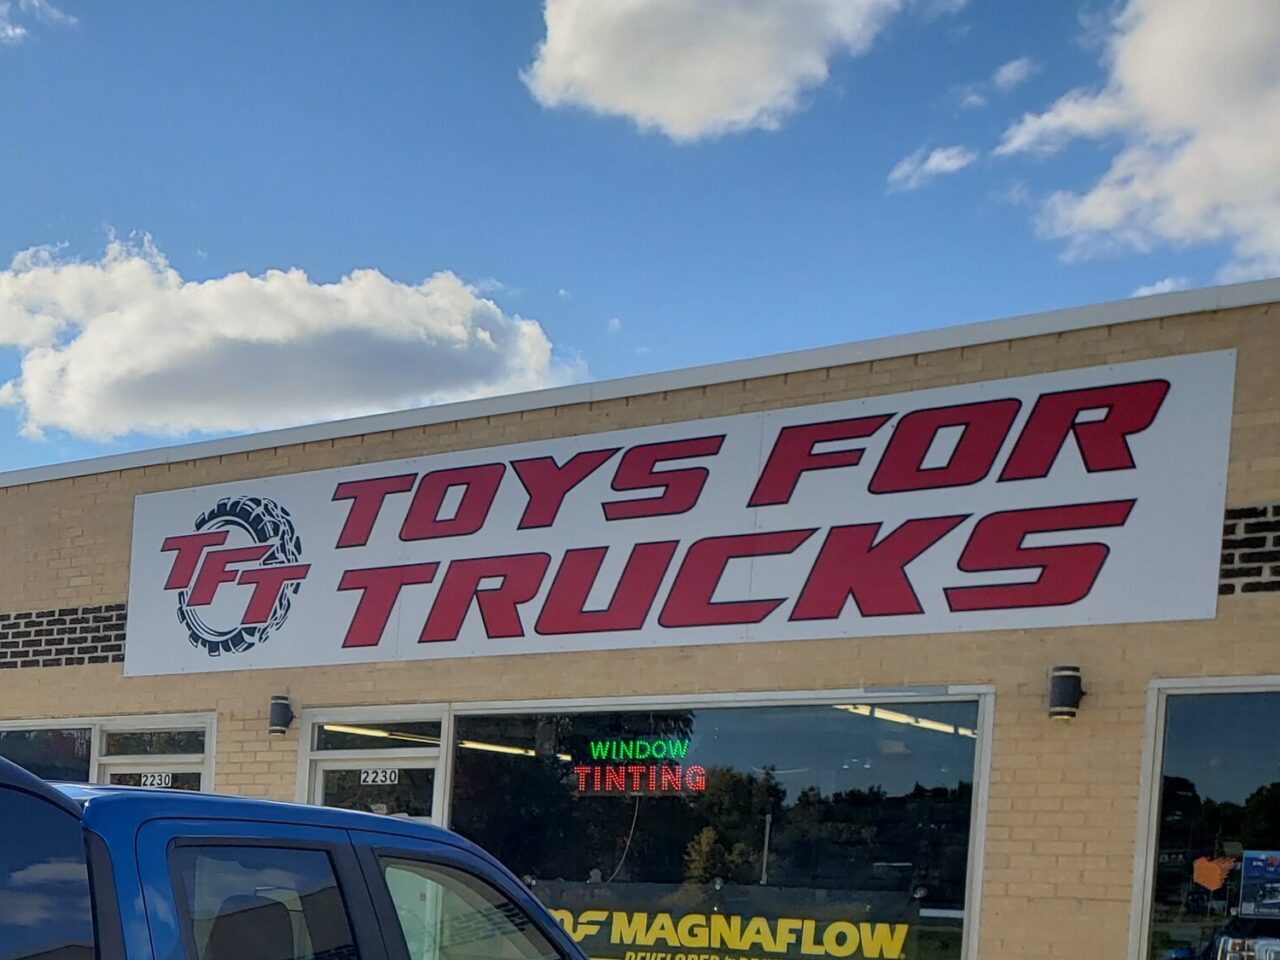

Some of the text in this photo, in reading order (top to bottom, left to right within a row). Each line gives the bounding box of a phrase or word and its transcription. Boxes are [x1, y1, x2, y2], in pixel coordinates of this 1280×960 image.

[332, 378, 1171, 550] TOYS FOR
[160, 530, 312, 625] TFT
[337, 499, 1138, 649] TRUCKS
[590, 739, 689, 759] WINDOW
[142, 774, 171, 786] 2230
[362, 770, 397, 783] 2230
[574, 764, 706, 791] TINTING
[610, 911, 909, 960] MAGNAFLOW
